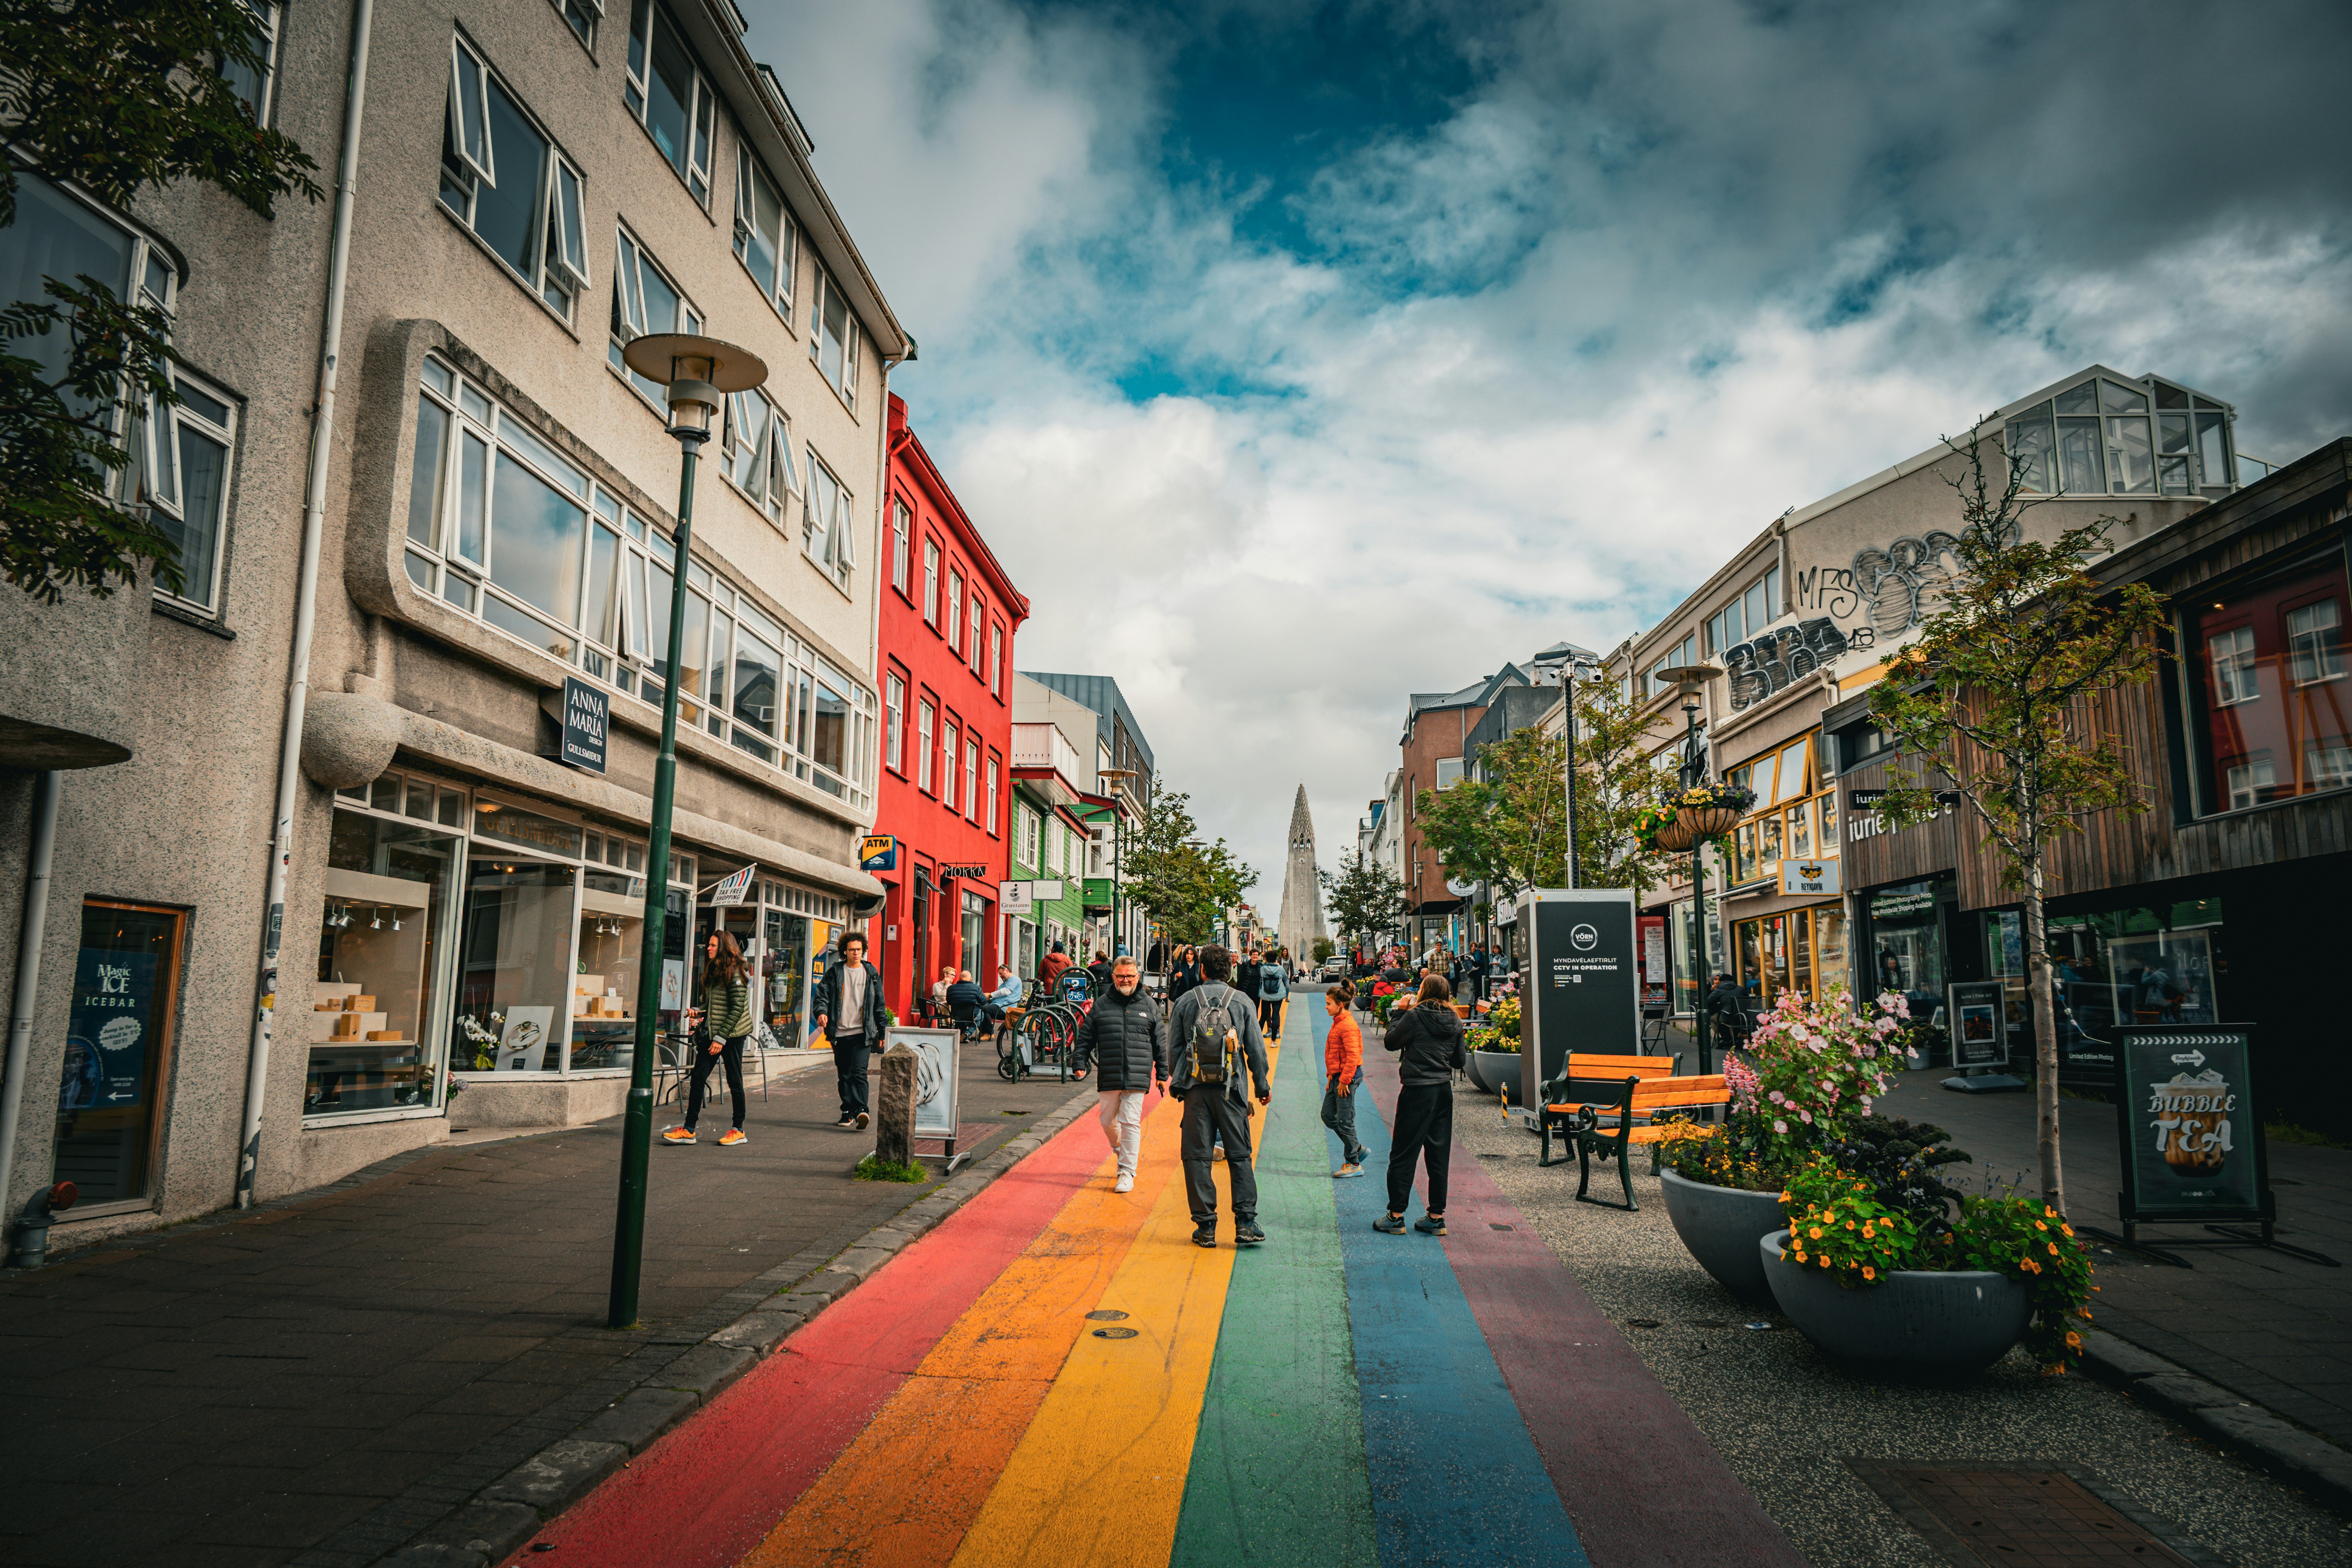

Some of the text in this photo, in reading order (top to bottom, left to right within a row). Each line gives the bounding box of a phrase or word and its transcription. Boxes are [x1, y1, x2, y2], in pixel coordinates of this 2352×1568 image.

[571, 688, 604, 718] ANNA
[569, 709, 603, 738] MARÍA
[589, 736, 603, 747] DESIGN
[568, 743, 602, 763] GULLSMIÐUR
[485, 810, 572, 850] GULLSMIÐUR
[866, 839, 889, 848] ATM
[945, 866, 984, 878] MOKKA
[1801, 881, 1823, 892] REYKJAVÍK
[1871, 900, 1884, 908] Limited
[1896, 894, 1920, 903] Photography
[97, 964, 131, 979] Magic
[813, 961, 824, 973] ATM
[102, 976, 130, 993] ICE
[1071, 980, 1080, 988] P
[86, 997, 135, 1007] ICEBAR
[2147, 1094, 2236, 1113] BUBBLE
[2150, 1115, 2234, 1152] TEA
